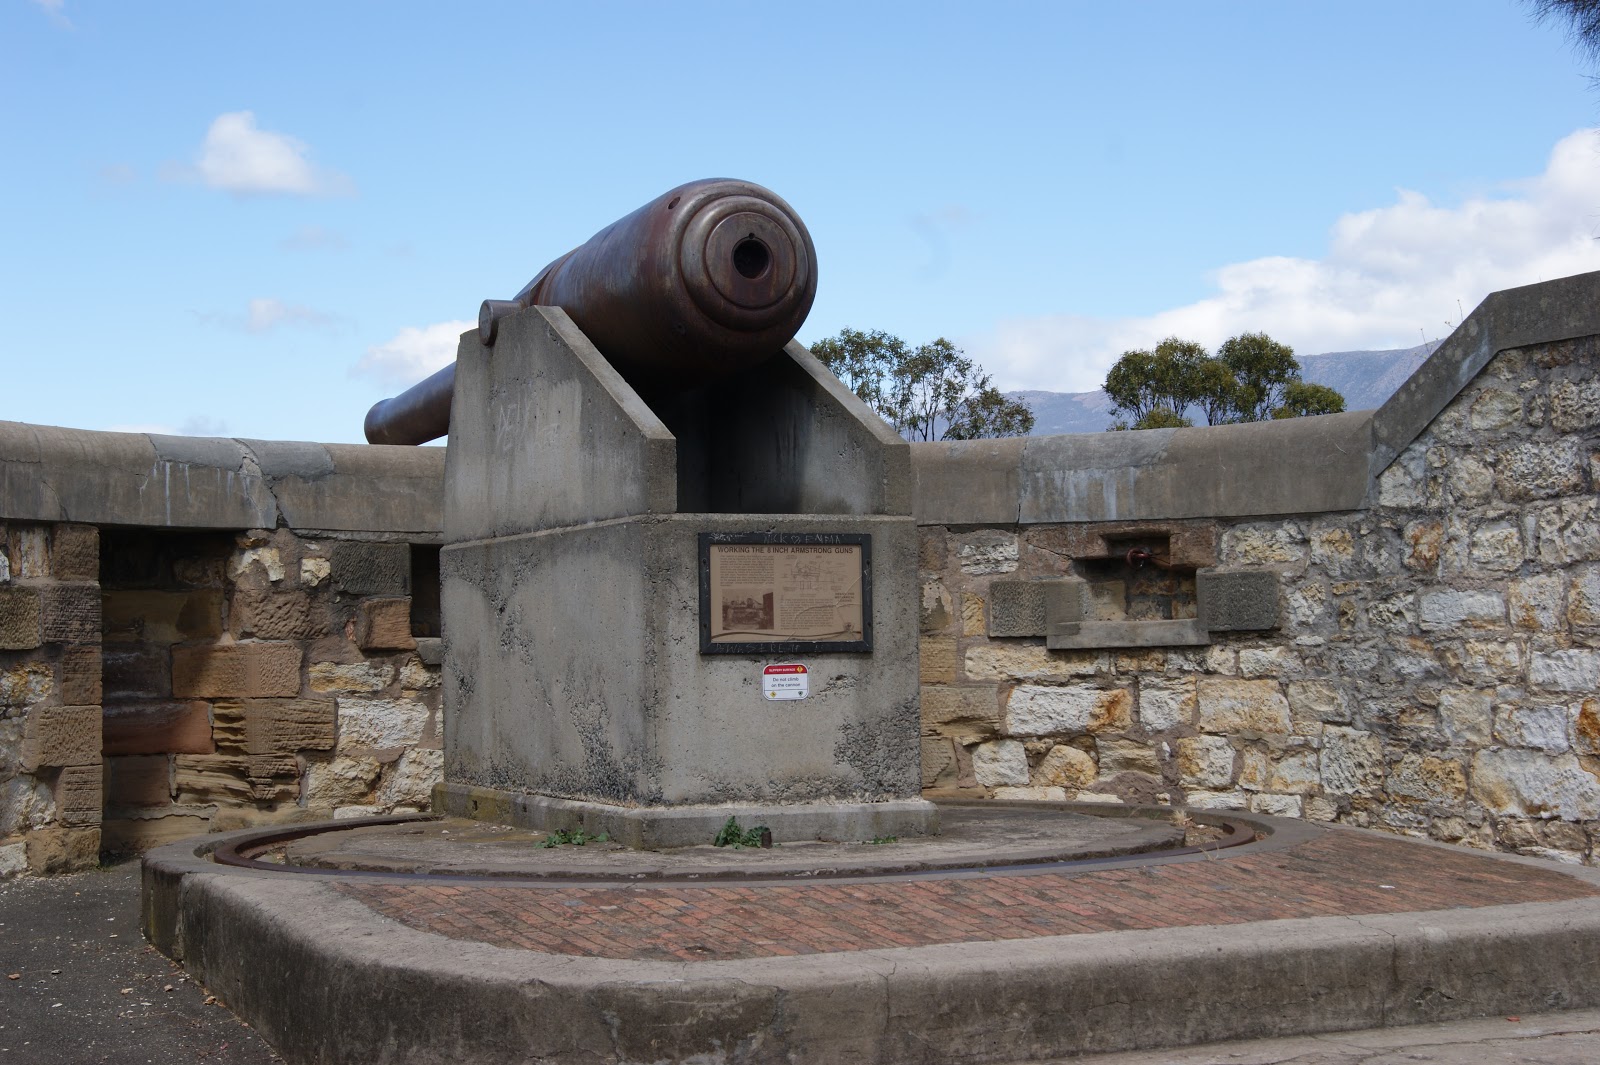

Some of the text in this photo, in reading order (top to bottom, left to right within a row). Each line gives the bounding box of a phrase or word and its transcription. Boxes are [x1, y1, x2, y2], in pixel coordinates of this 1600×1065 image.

[717, 546, 854, 554] WORKING THE 8 INCH ARMSTRONG GUNS
